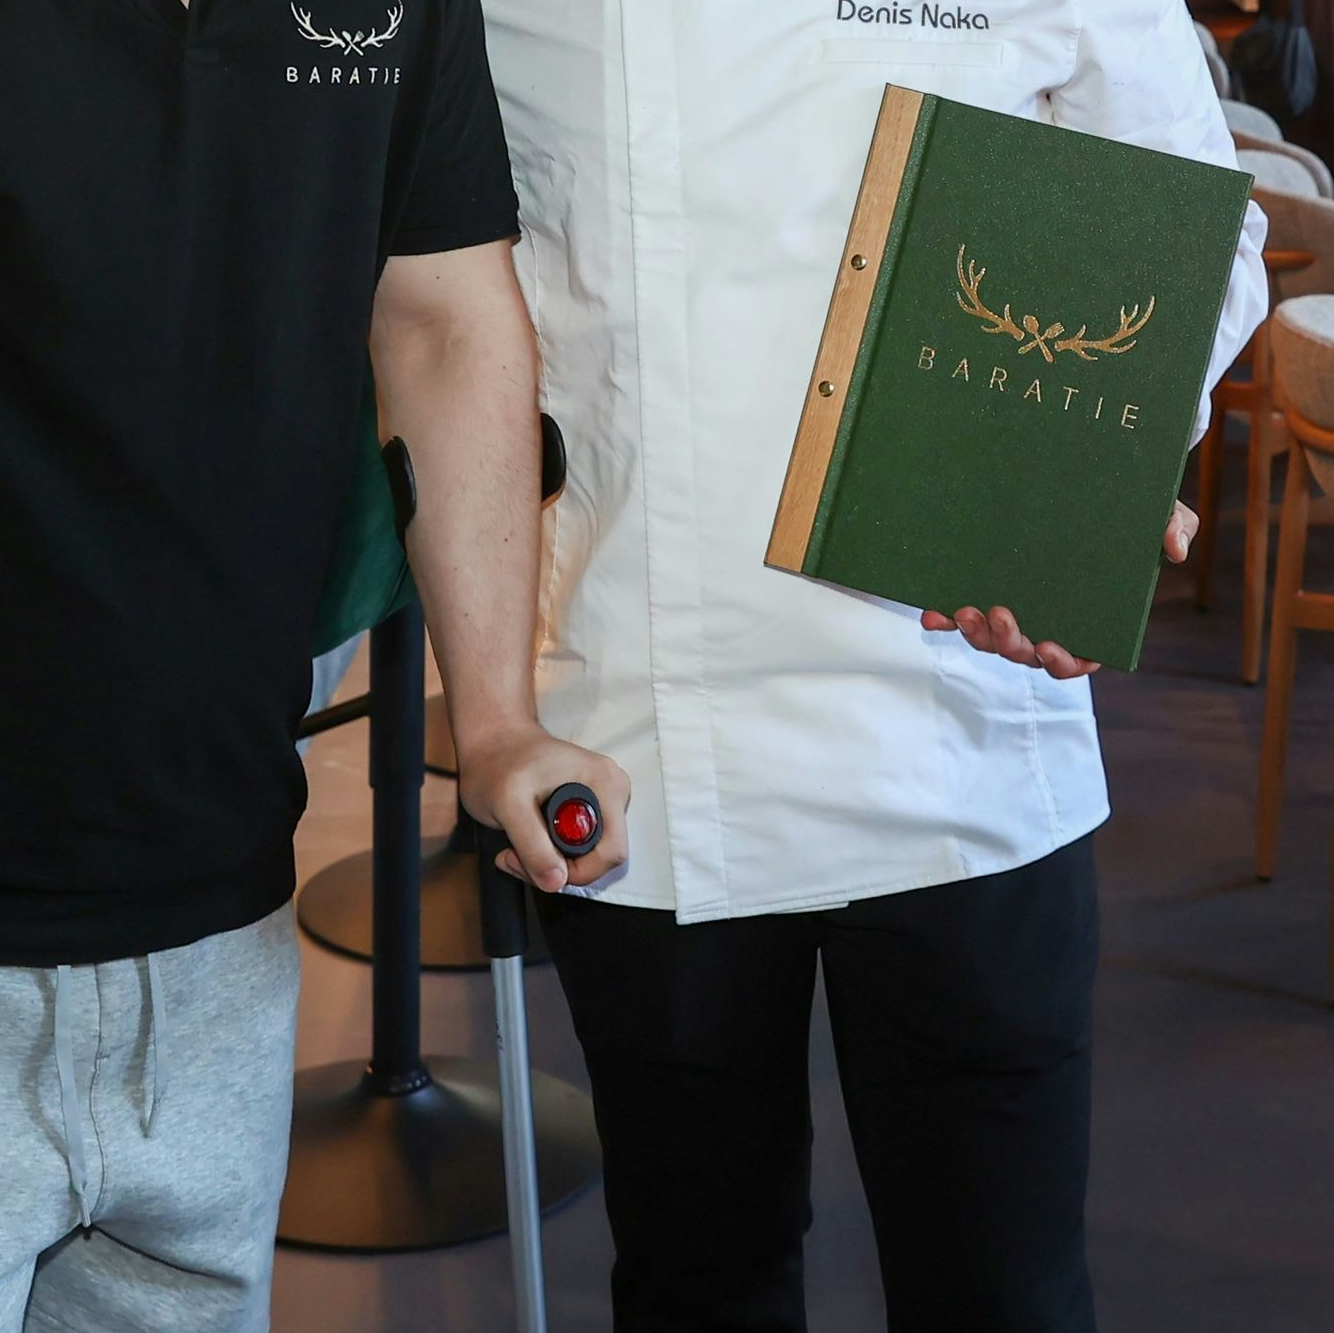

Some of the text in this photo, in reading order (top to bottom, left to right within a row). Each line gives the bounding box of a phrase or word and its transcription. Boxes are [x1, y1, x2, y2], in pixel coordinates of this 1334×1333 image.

[921, 2, 990, 30] Naka
[285, 66, 401, 85] BARATIE
[917, 345, 1140, 430] BARATIE
